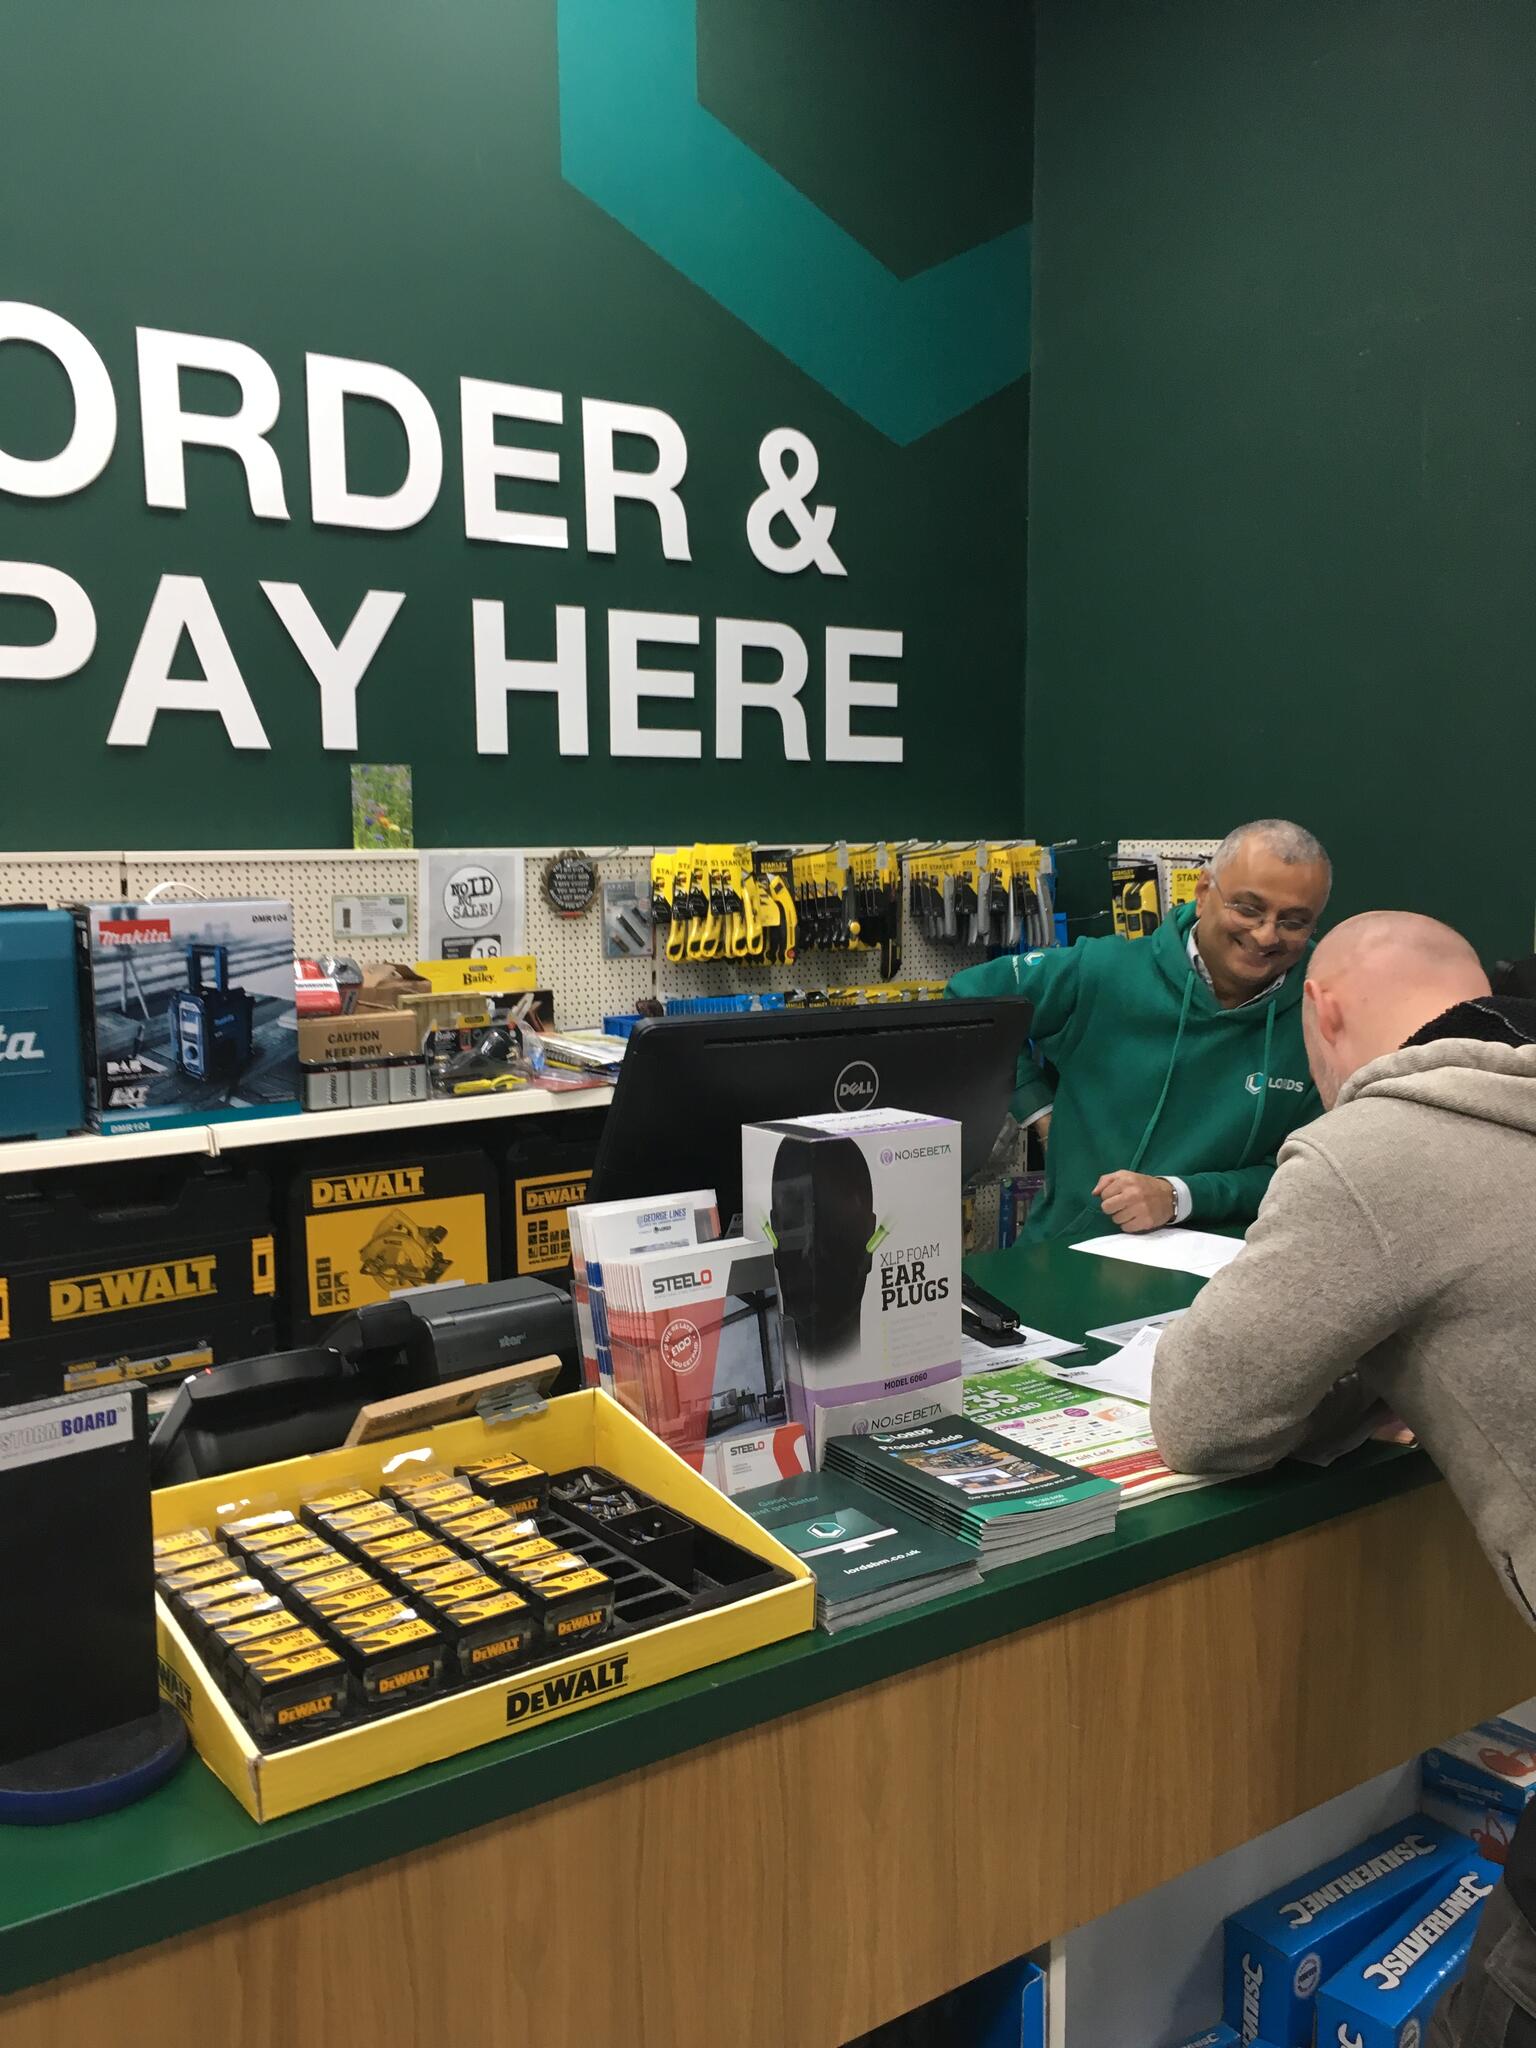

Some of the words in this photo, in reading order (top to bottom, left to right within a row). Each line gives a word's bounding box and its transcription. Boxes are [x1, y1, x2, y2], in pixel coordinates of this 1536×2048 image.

[0, 300, 692, 561] ORDER
[746, 427, 848, 576] &
[0, 560, 406, 751] PAY
[472, 598, 904, 763] HERE
[453, 903, 493, 919] SALE!
[463, 972, 495, 986] Bailey
[328, 1030, 379, 1044] CAUTION
[325, 1047, 356, 1059] KEEP
[359, 1044, 383, 1055] DRY
[839, 1080, 874, 1096] DELL
[643, 1209, 669, 1223] GEORGE
[669, 1207, 687, 1220] LINES
[880, 1250, 904, 1267] XLP
[907, 1242, 940, 1262] FOAM
[652, 1269, 713, 1294] STEELO
[881, 1261, 926, 1289] EAR
[882, 1277, 949, 1311] PLUGS
[884, 1377, 909, 1390] MODEL
[910, 1372, 928, 1384] 6060
[730, 1441, 765, 1456] STEELO
[878, 1441, 928, 1451] Product
[927, 1434, 964, 1445] Guide
[1383, 1880, 1480, 1979] SILVERLINE
